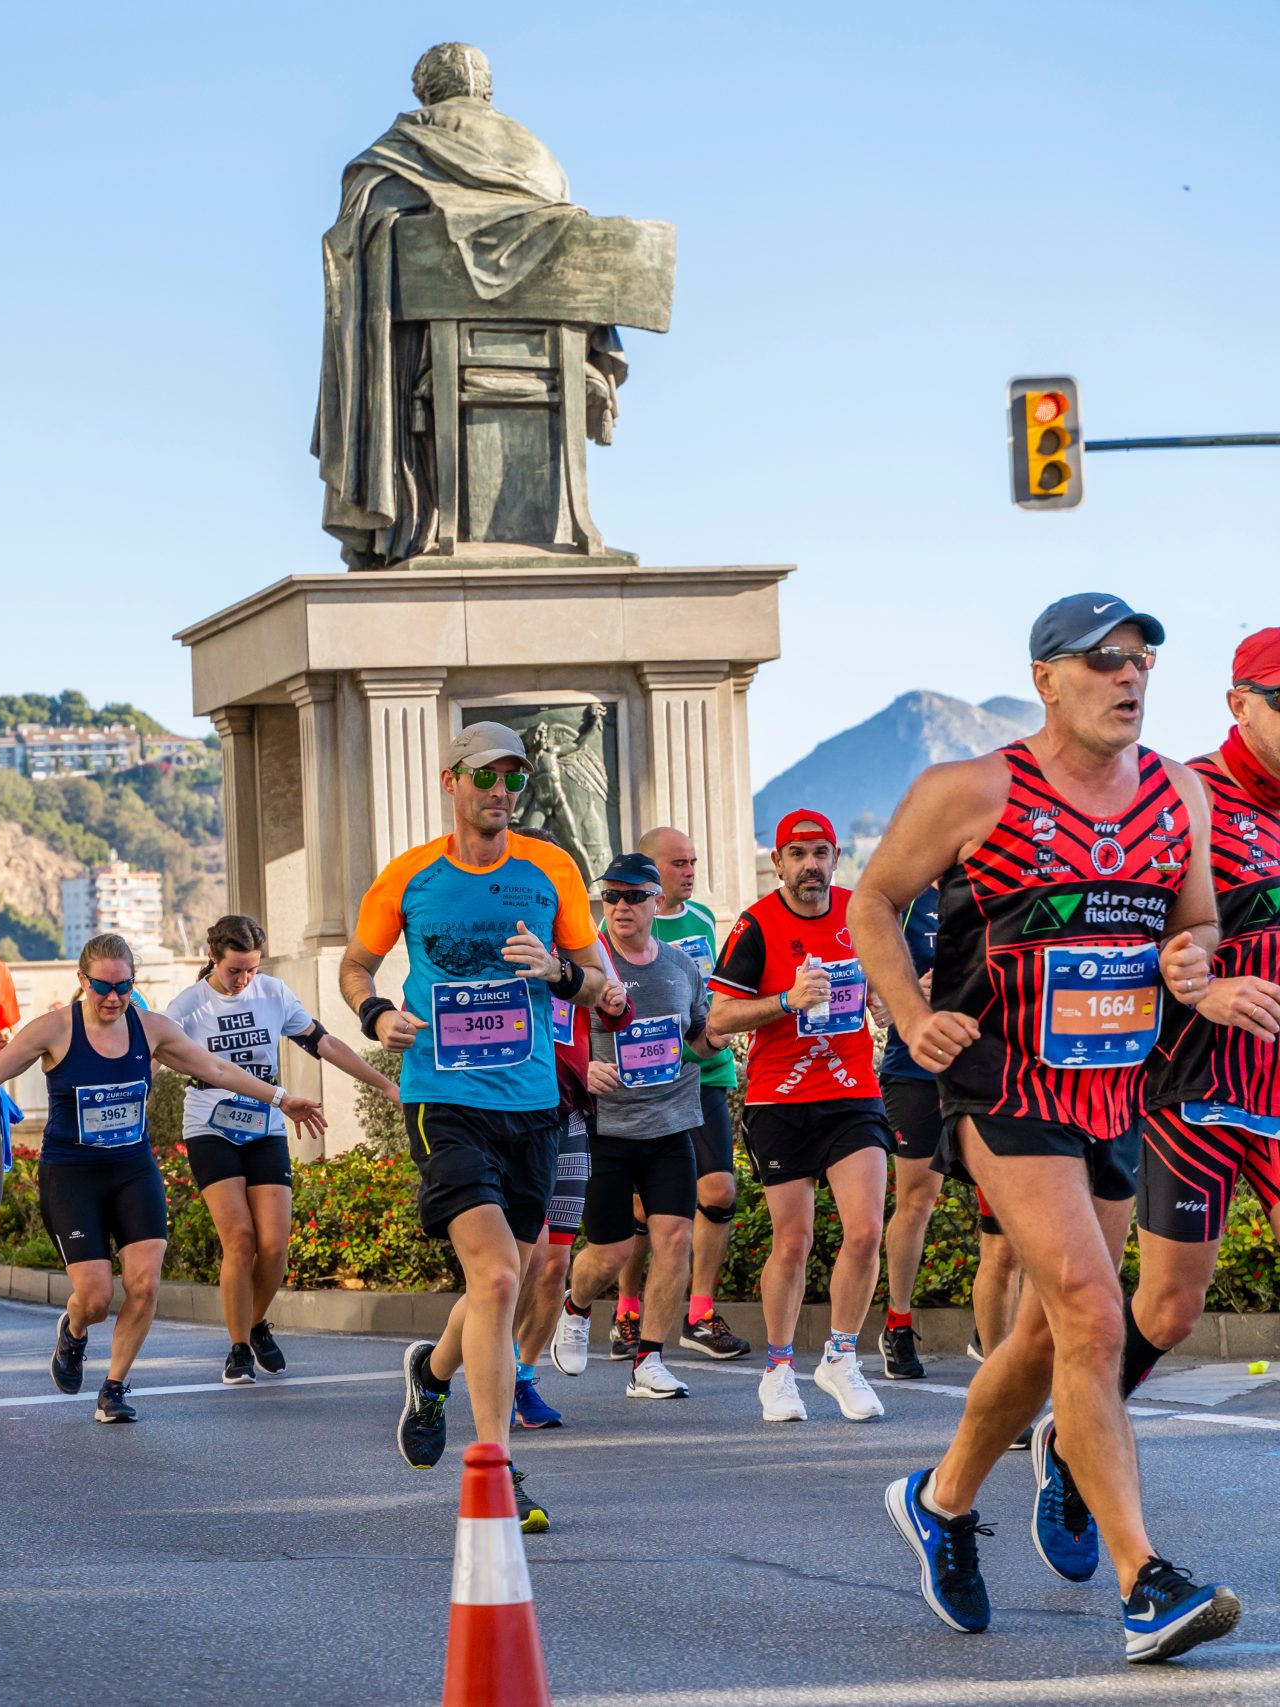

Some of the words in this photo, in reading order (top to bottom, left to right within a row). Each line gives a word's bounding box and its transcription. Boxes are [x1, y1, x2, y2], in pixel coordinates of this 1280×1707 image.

[1093, 821, 1121, 834] vive
[1021, 868, 1038, 876] LAS
[1040, 864, 1071, 875] VEGAS
[1240, 863, 1255, 873] LAS
[1256, 859, 1279, 869] VEGAS
[503, 885, 533, 893] ZURICH
[472, 920, 546, 936] MARAON
[829, 969, 855, 979] ZURICH
[1101, 962, 1145, 975] ZURICH
[473, 991, 510, 1001] ZURICH
[830, 989, 852, 1004] 965
[1087, 994, 1135, 1017] 1664
[221, 1013, 252, 1030] THE
[464, 1015, 504, 1032] 3403
[643, 1025, 667, 1035] ZURICH
[210, 1031, 268, 1051] FUTURE
[235, 1052, 249, 1062] IS
[639, 1044, 665, 1058] 2865
[105, 1091, 132, 1099] ZURICH
[100, 1107, 128, 1122] 3962
[228, 1109, 253, 1124] 4328
[1175, 1200, 1209, 1212] vive
